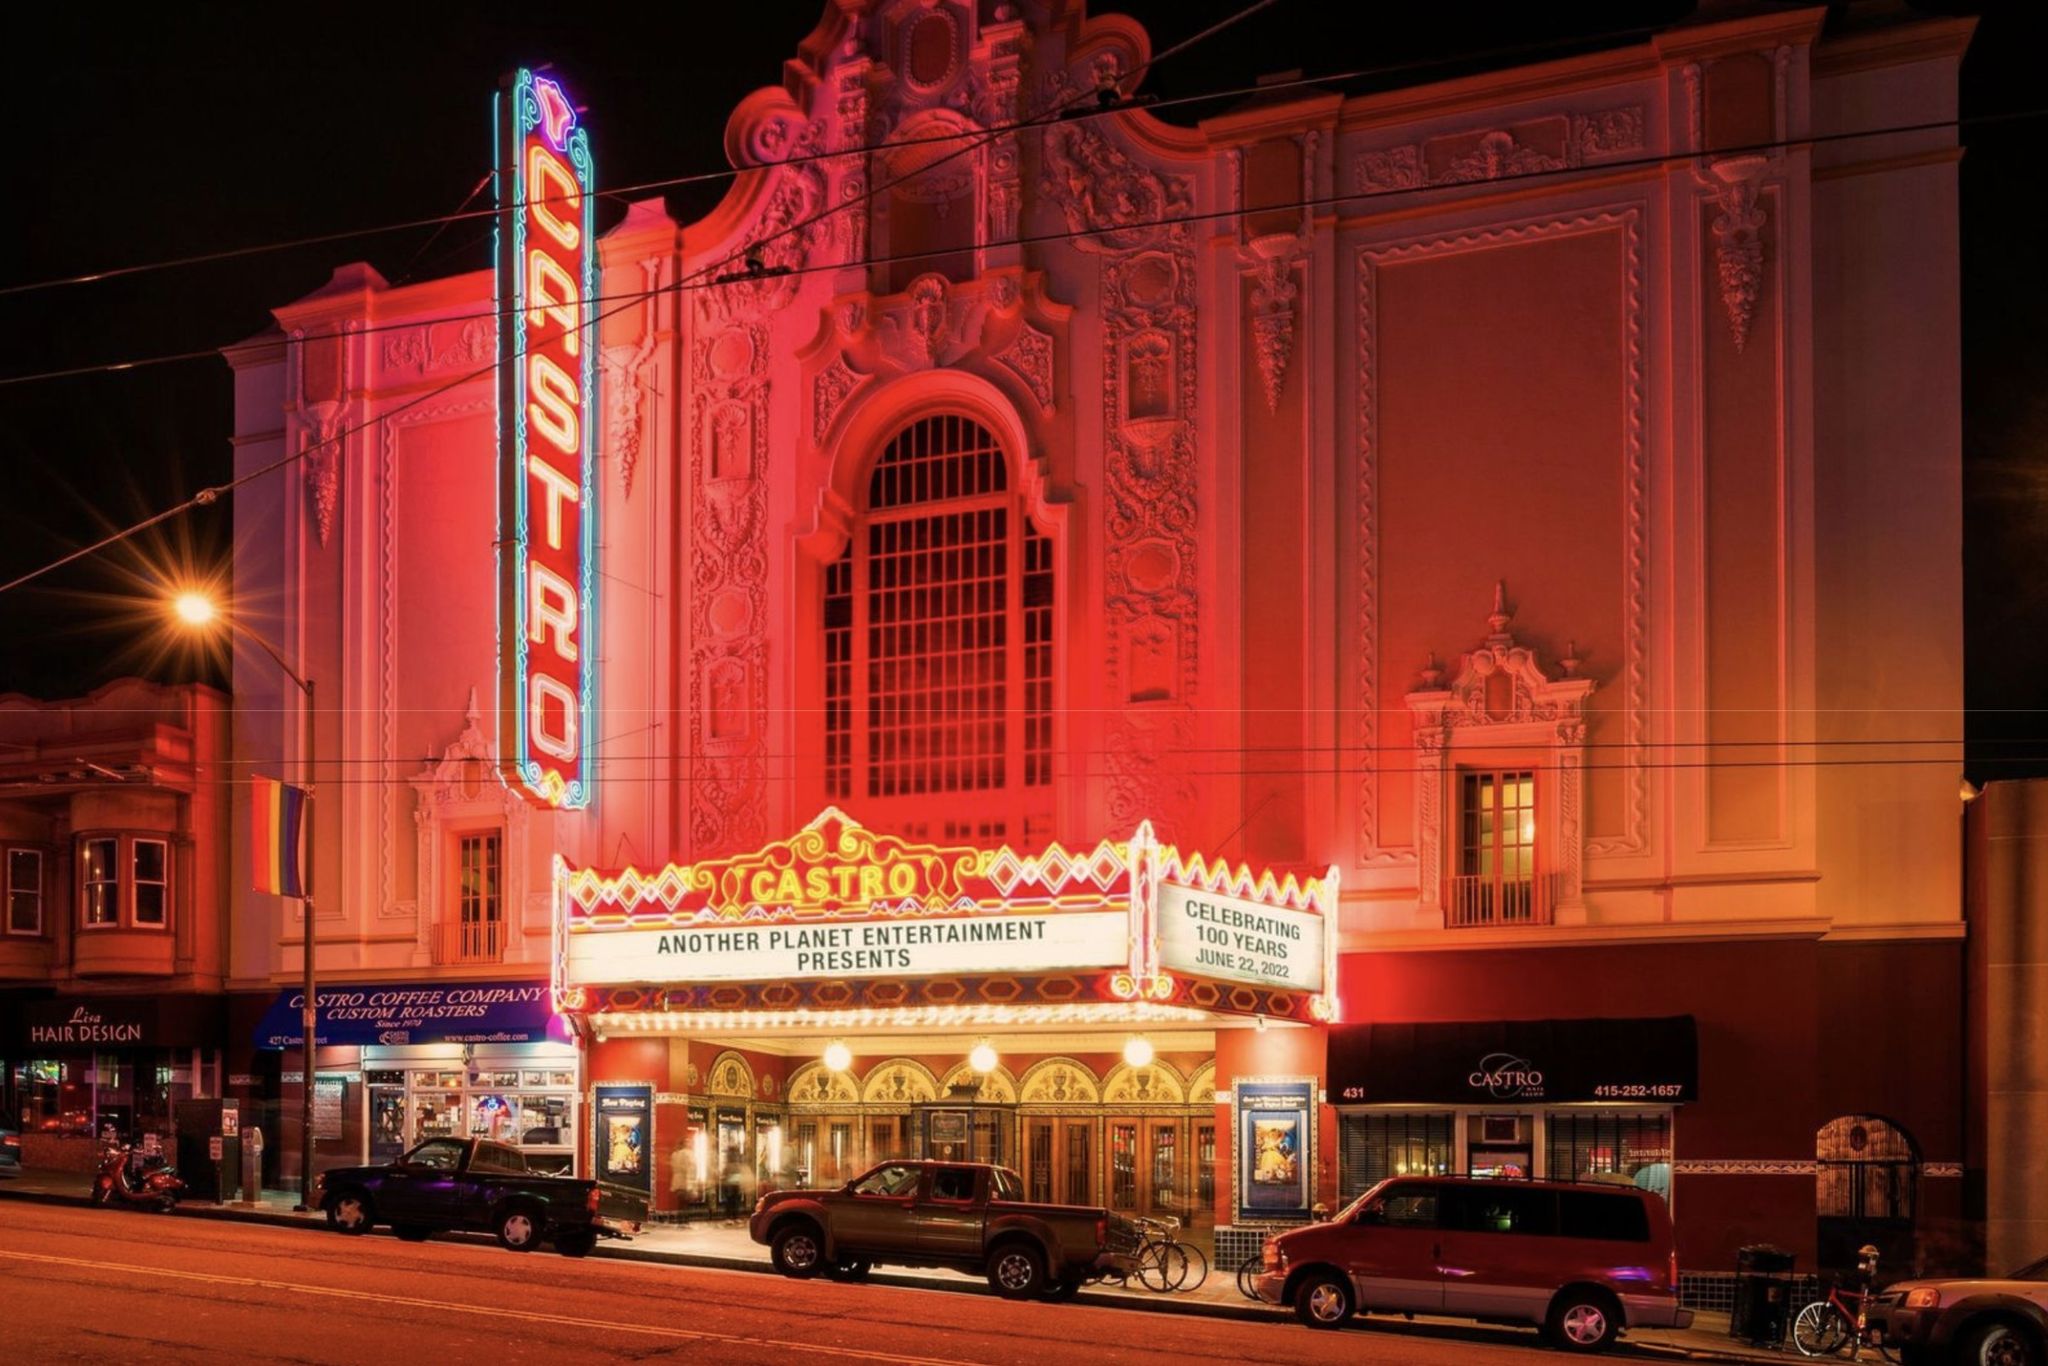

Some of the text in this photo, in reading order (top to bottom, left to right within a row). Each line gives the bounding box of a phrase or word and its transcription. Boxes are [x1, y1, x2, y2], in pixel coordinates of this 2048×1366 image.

[528, 144, 580, 763] CASTRO
[751, 863, 917, 905] CASTRO
[1185, 899, 1300, 940] CELEBRATING
[657, 921, 1046, 955] ANOTHER PLANET ENTERTAINMENT
[1196, 924, 1288, 959] 100 YEARS
[797, 949, 911, 971] PRESENTS
[1195, 948, 1289, 978] JUNE 22, 2022
[289, 987, 547, 1009] CSTRO COFFEE COMPANY
[69, 1006, 101, 1024] Lisa
[326, 1005, 488, 1020] CUSTOM ROASTERS
[32, 1024, 141, 1042] HAIR DESIGN
[375, 1020, 400, 1028] Since
[445, 1031, 529, 1042] www.castro-coffee.com
[1469, 1071, 1543, 1087] CASTRO
[1343, 1087, 1364, 1099] 431
[1595, 1085, 1683, 1097] 415-252-1657
